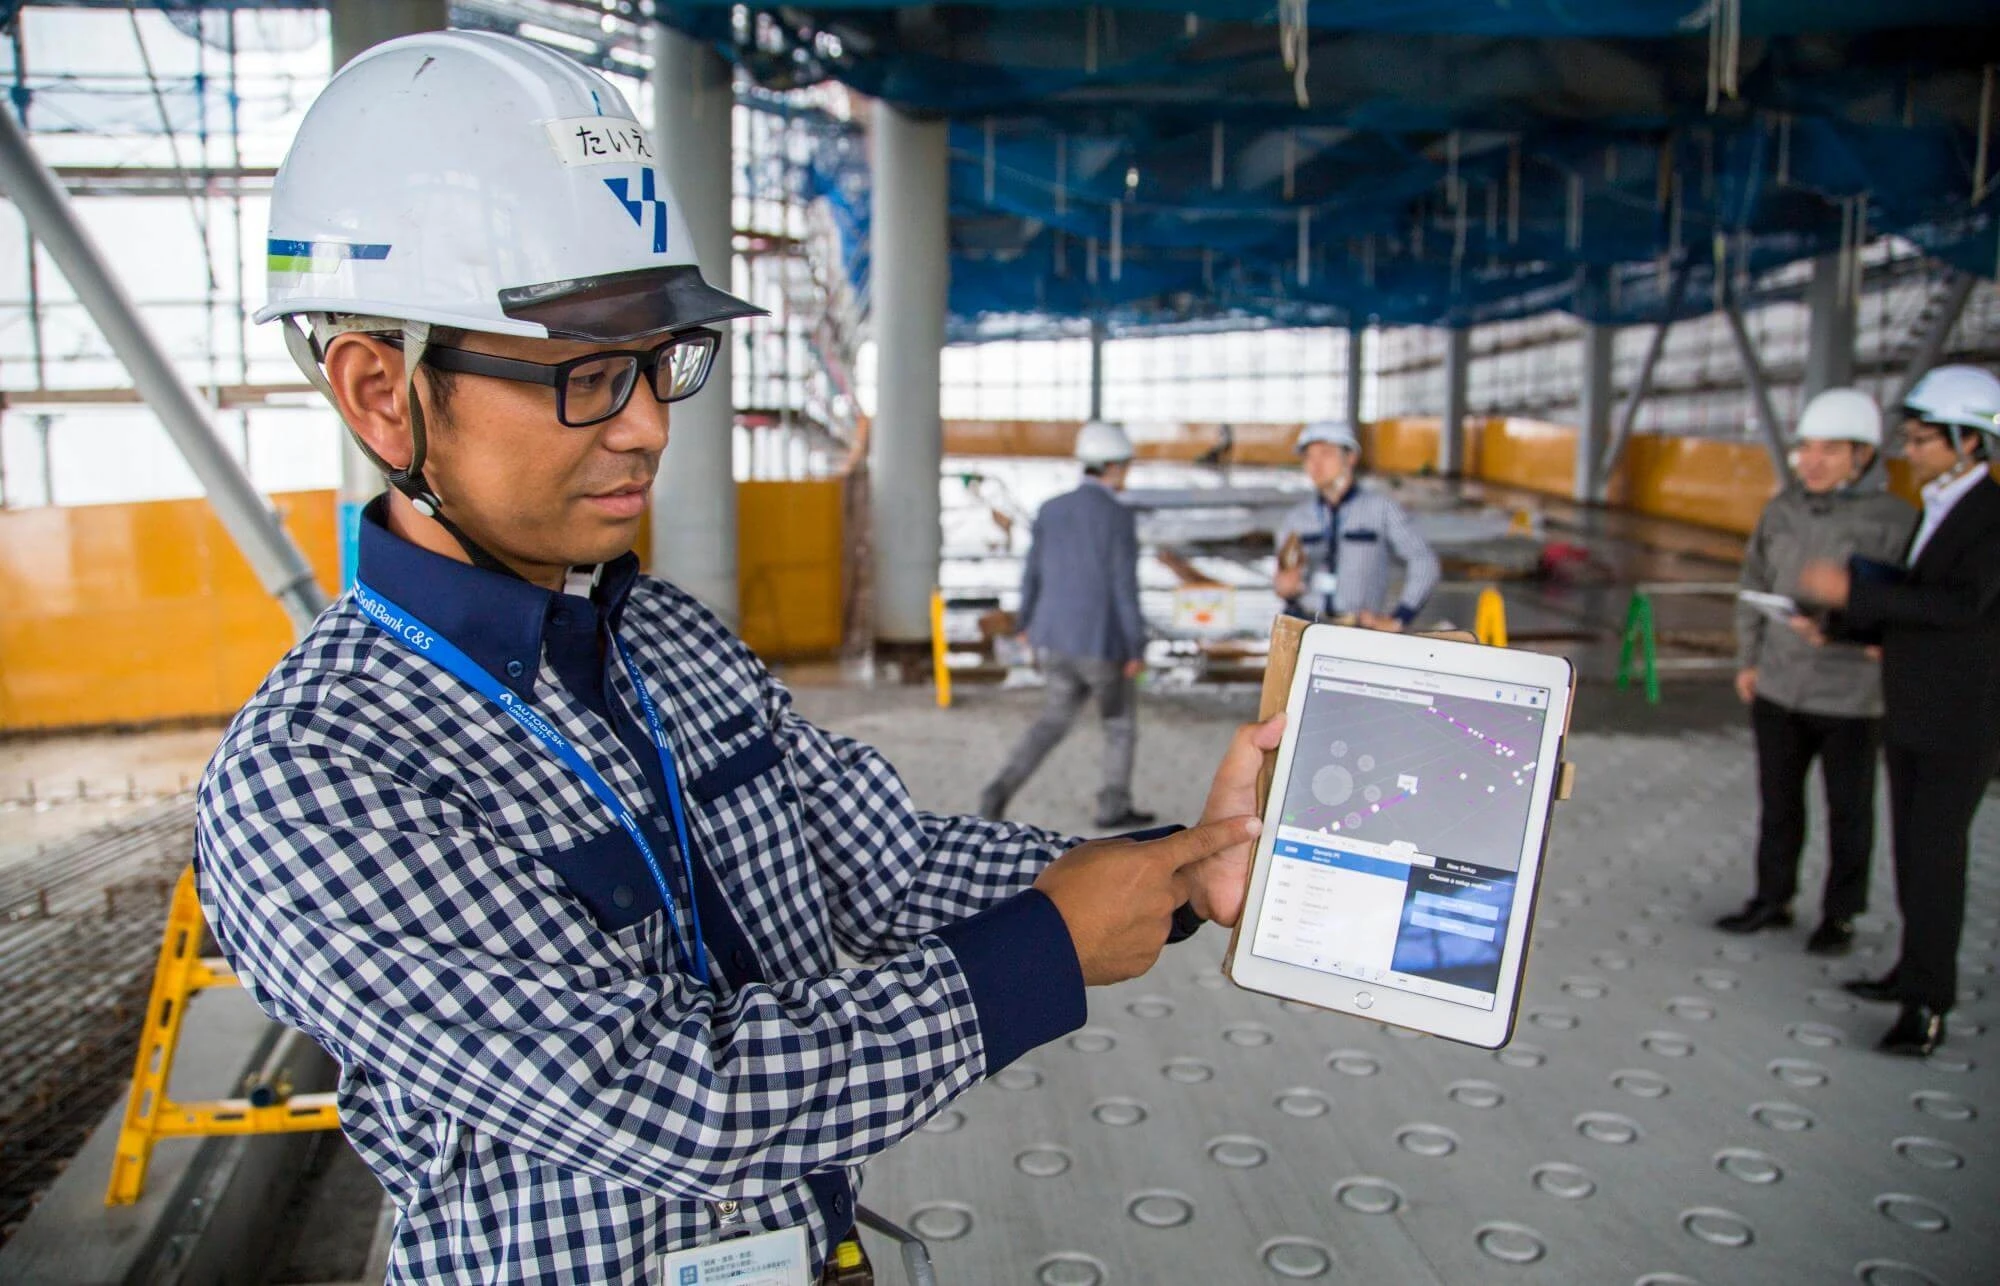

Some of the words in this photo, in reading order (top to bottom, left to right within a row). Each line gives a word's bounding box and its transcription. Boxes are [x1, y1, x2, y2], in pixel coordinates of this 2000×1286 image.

[576, 125, 653, 158] たいえ
[358, 589, 404, 633] SoftBank
[403, 625, 434, 650] C&S
[508, 706, 547, 739] UNIVERSITY
[513, 704, 565, 748] AUTODESK
